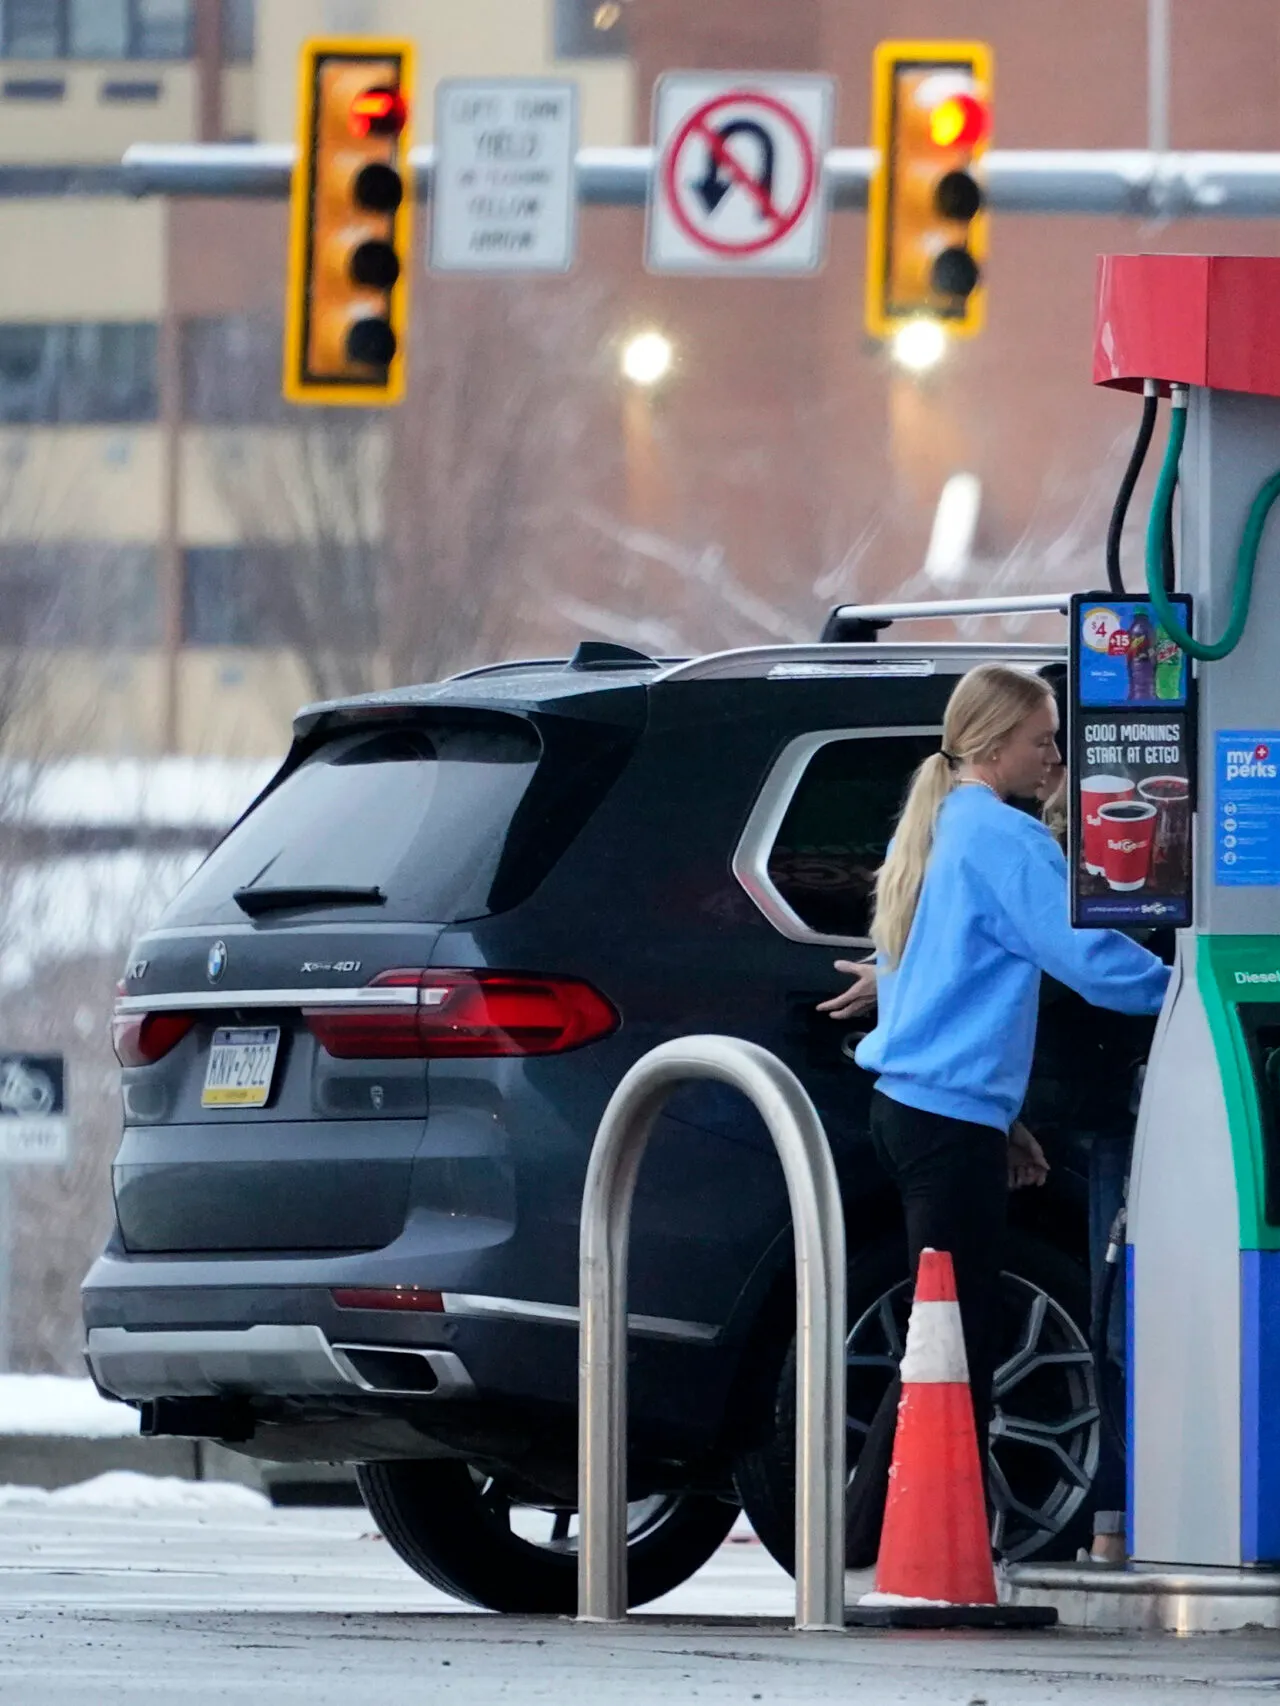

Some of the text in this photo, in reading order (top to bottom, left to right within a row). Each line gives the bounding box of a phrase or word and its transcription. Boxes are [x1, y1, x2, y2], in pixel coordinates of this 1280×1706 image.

[1084, 723, 1180, 742] GOOD MORNINGS
[1086, 746, 1180, 764] START AT GETGO
[1226, 750, 1254, 764] my
[1226, 762, 1277, 780] perks
